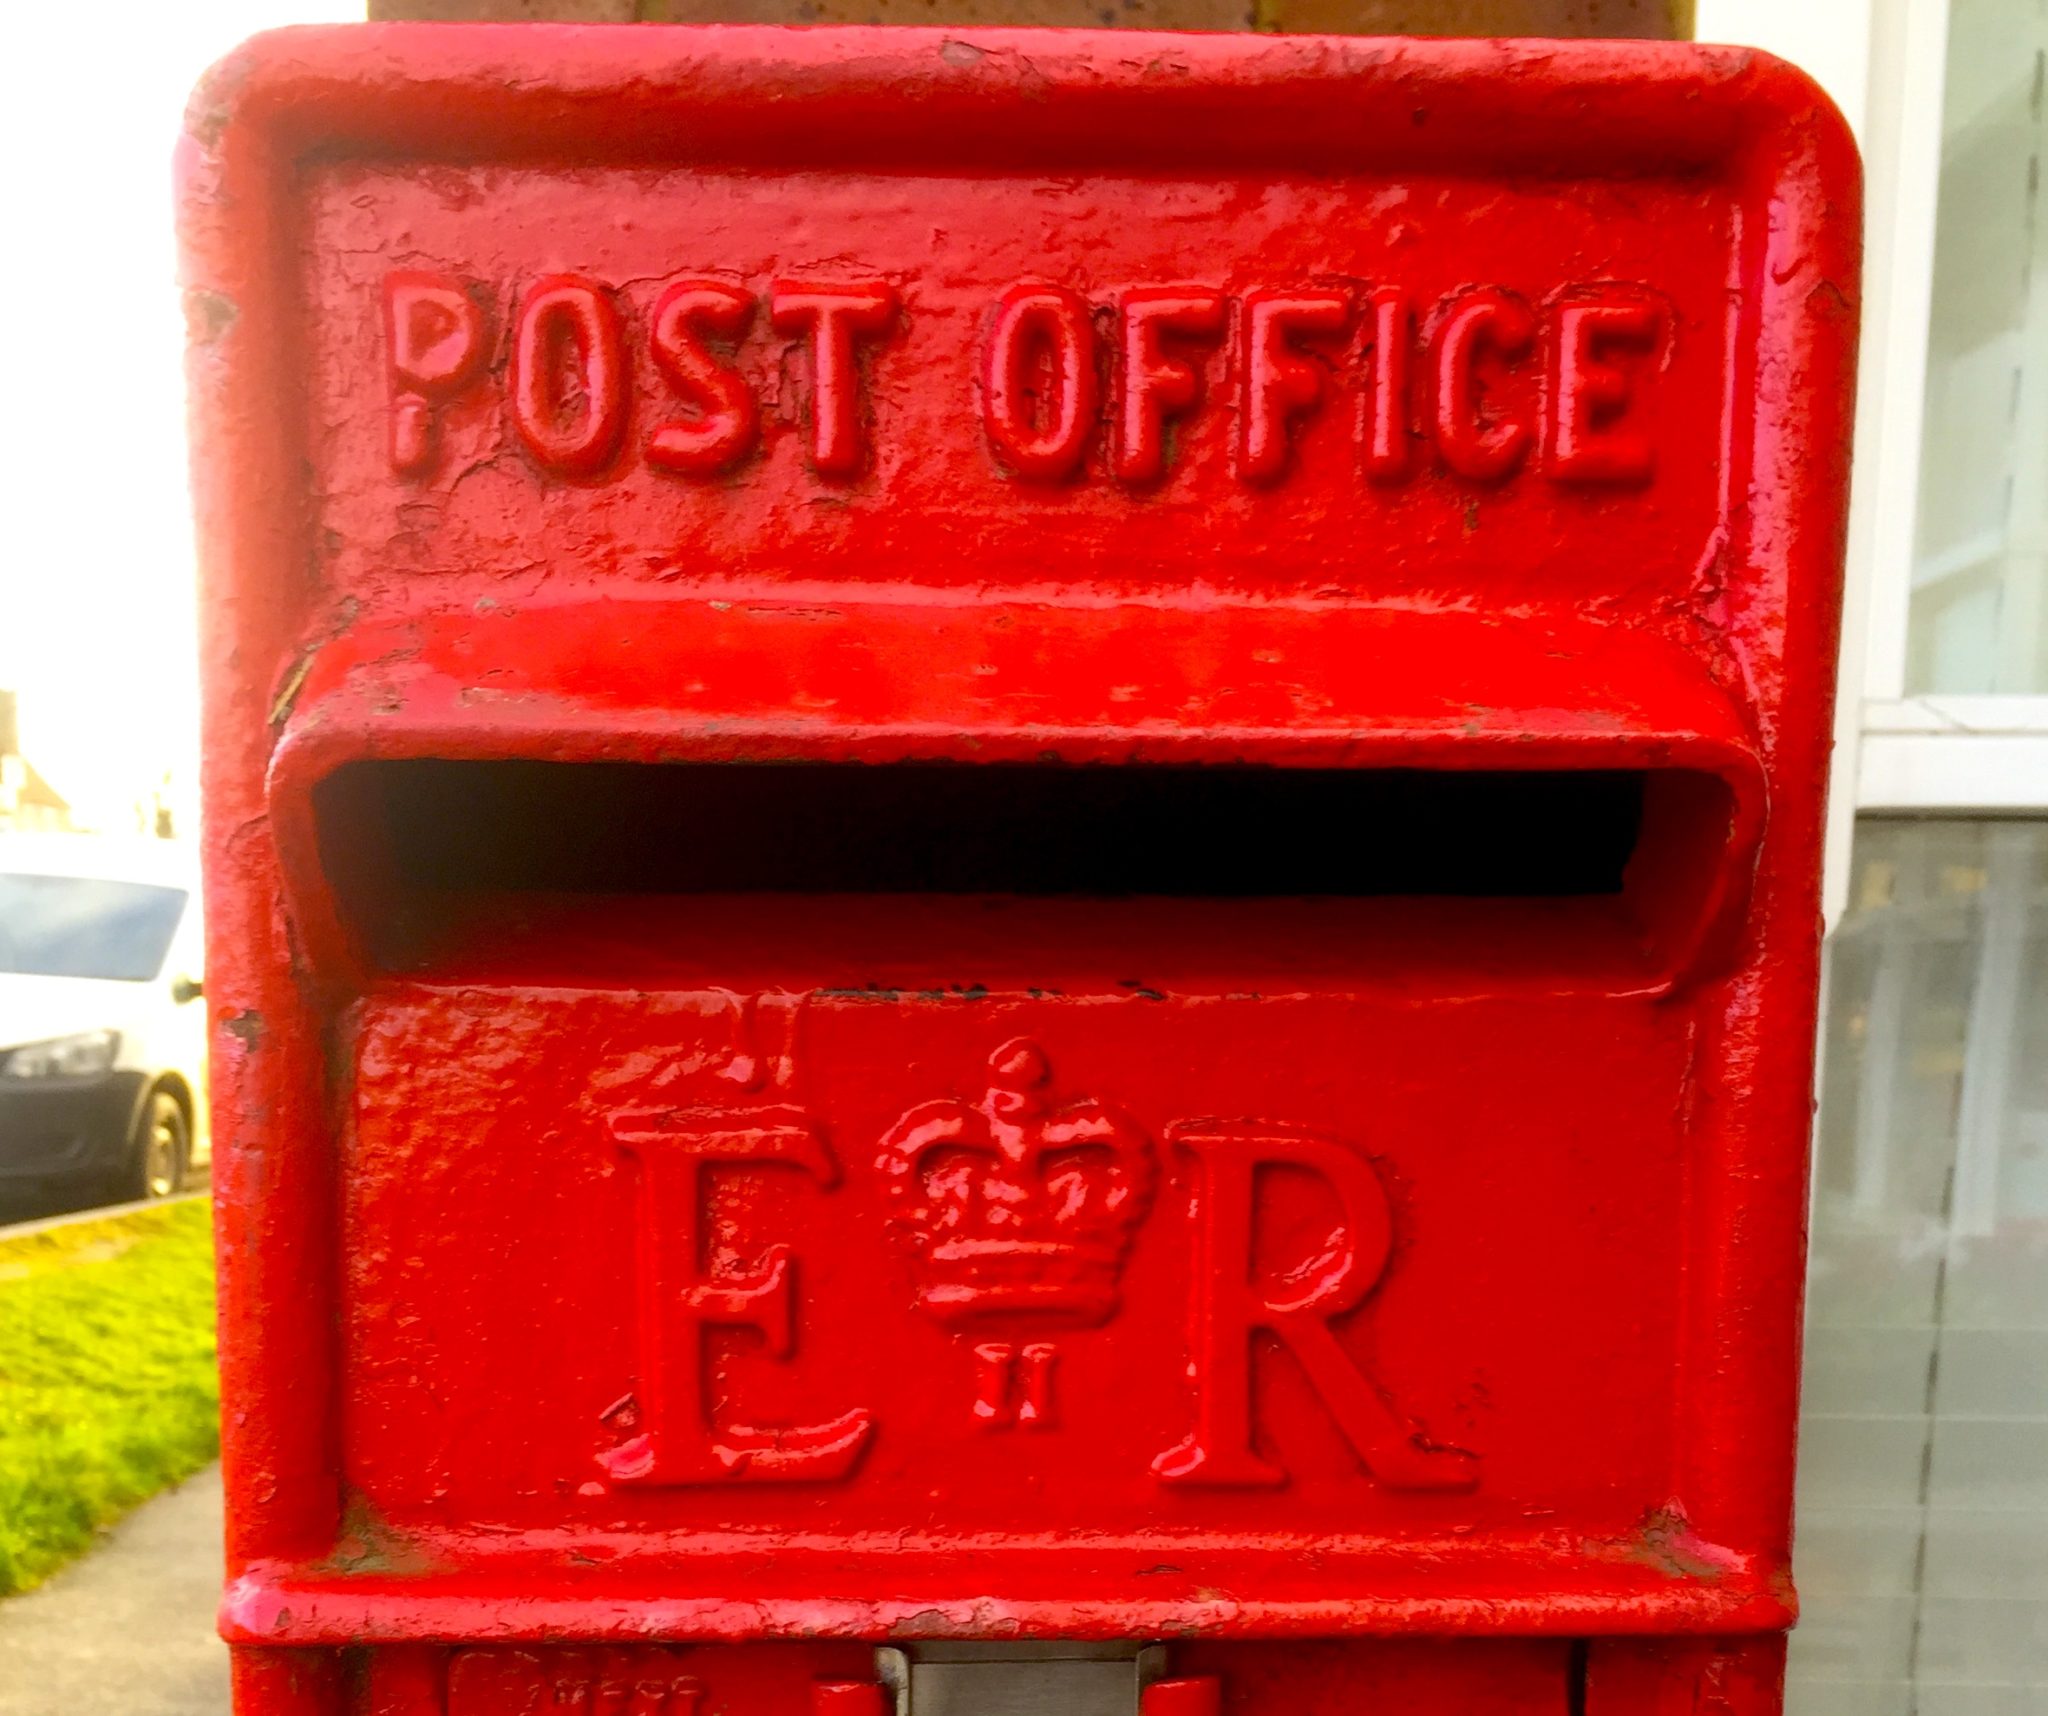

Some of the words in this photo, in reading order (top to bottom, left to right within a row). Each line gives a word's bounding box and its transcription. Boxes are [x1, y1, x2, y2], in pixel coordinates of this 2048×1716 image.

[385, 270, 898, 486] POST
[984, 284, 1658, 488] OFFICE
[600, 1104, 876, 1486] E
[1150, 1116, 1480, 1490] R
